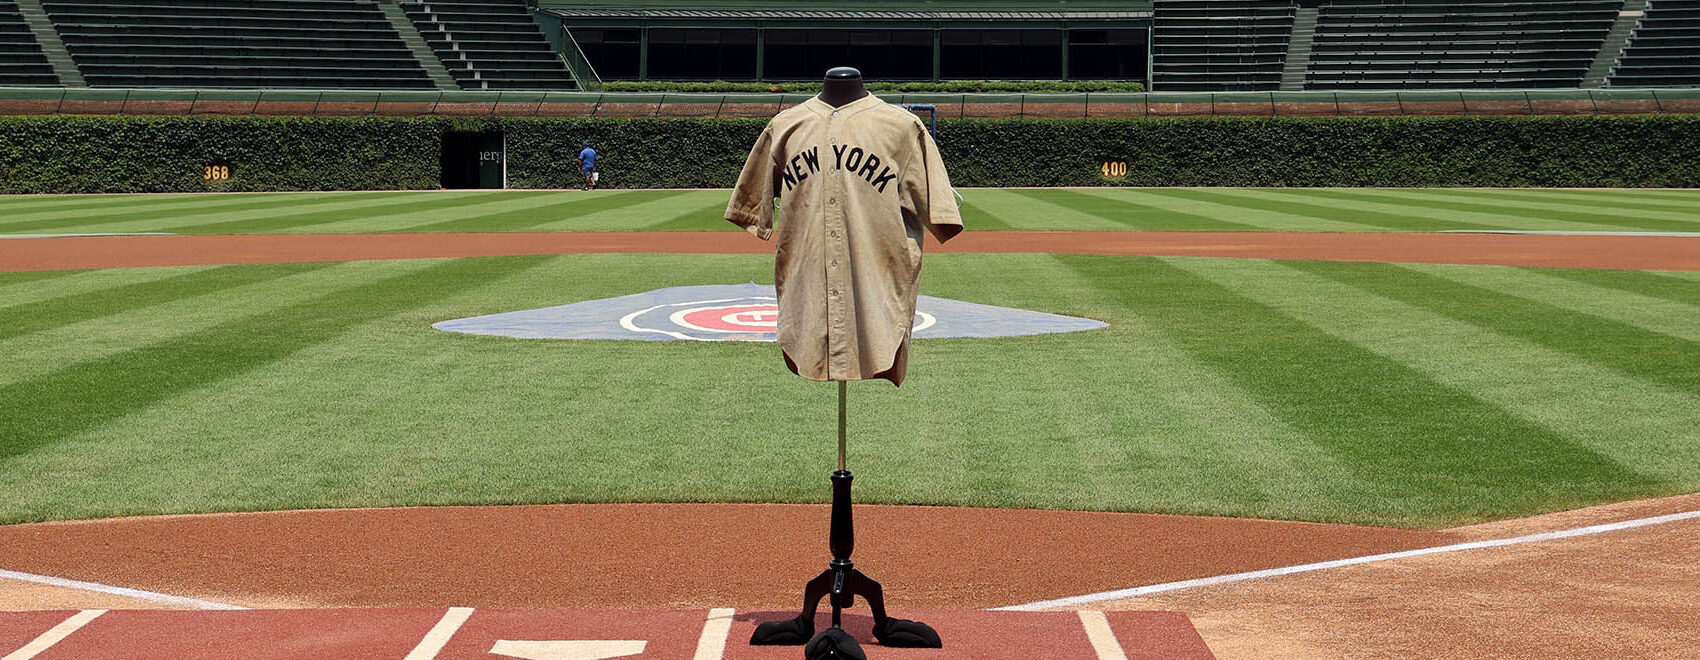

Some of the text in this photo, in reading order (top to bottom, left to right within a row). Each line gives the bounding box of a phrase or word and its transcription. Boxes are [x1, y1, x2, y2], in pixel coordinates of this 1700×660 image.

[203, 165, 229, 180] 368
[782, 144, 896, 194] NEW YORK
[1101, 161, 1127, 177] 400
